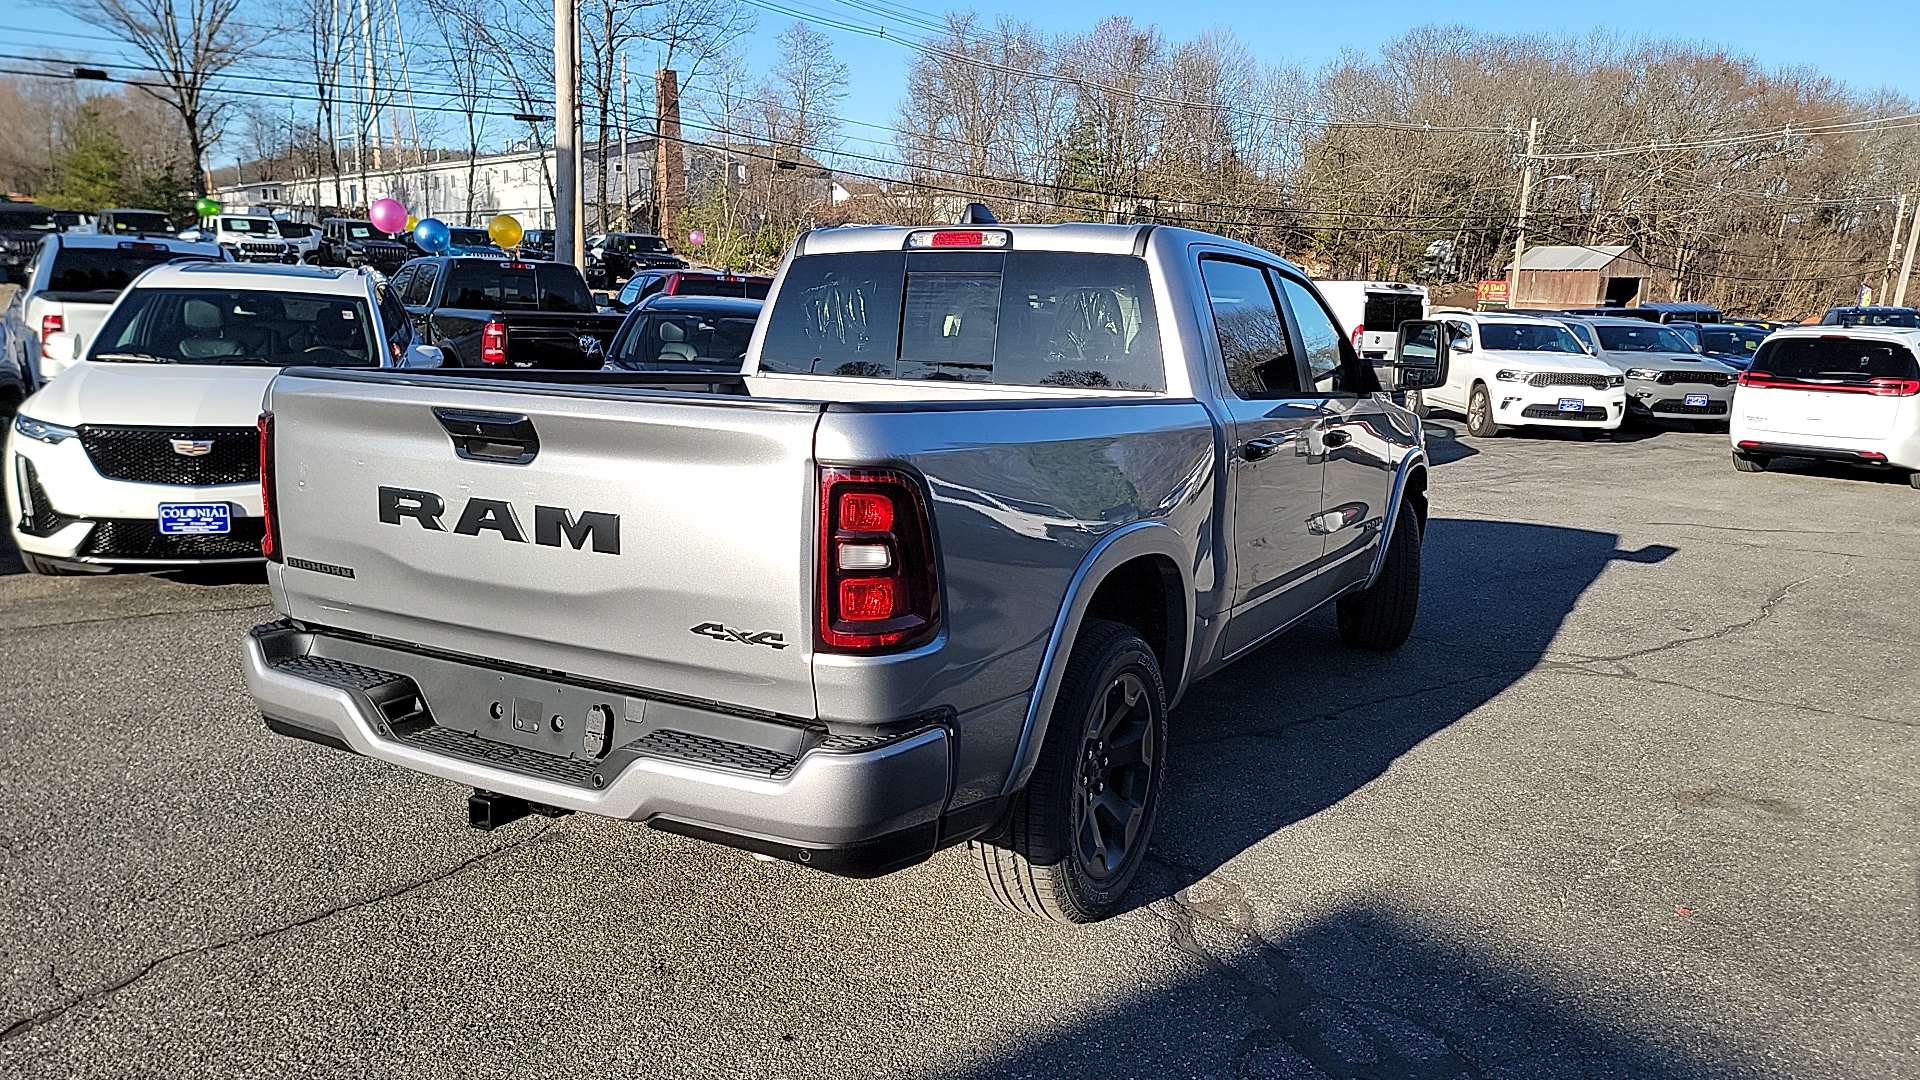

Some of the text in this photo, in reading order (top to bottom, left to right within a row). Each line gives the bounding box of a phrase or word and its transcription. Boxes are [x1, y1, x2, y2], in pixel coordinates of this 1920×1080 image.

[161, 507, 228, 519] COLONIAL
[378, 485, 621, 555] RAM
[288, 558, 353, 578] BIGHORN
